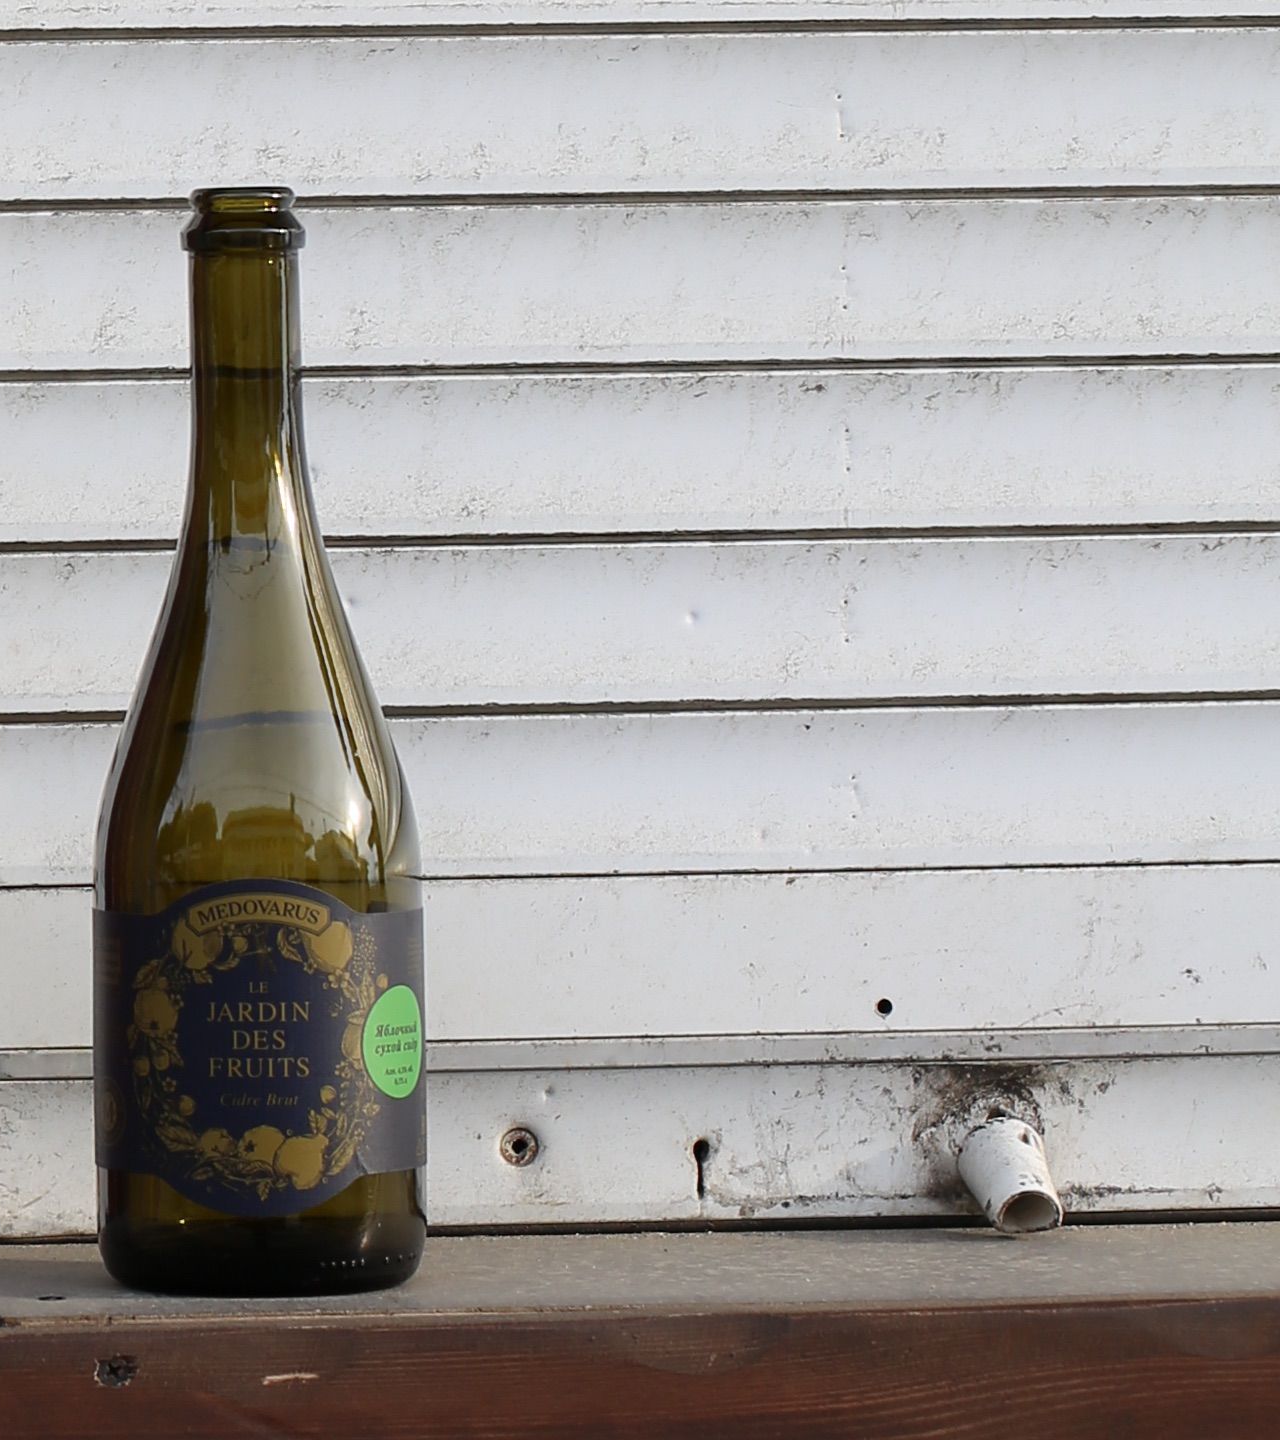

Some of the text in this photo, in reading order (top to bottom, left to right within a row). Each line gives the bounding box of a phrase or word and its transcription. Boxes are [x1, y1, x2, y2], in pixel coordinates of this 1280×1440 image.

[196, 899, 320, 926] MEDOVARUS
[249, 981, 269, 993] LE
[206, 1000, 311, 1023] JARDIN
[231, 1028, 286, 1051] DES
[208, 1056, 310, 1079] FRUITS
[267, 1091, 300, 1106] Brut
